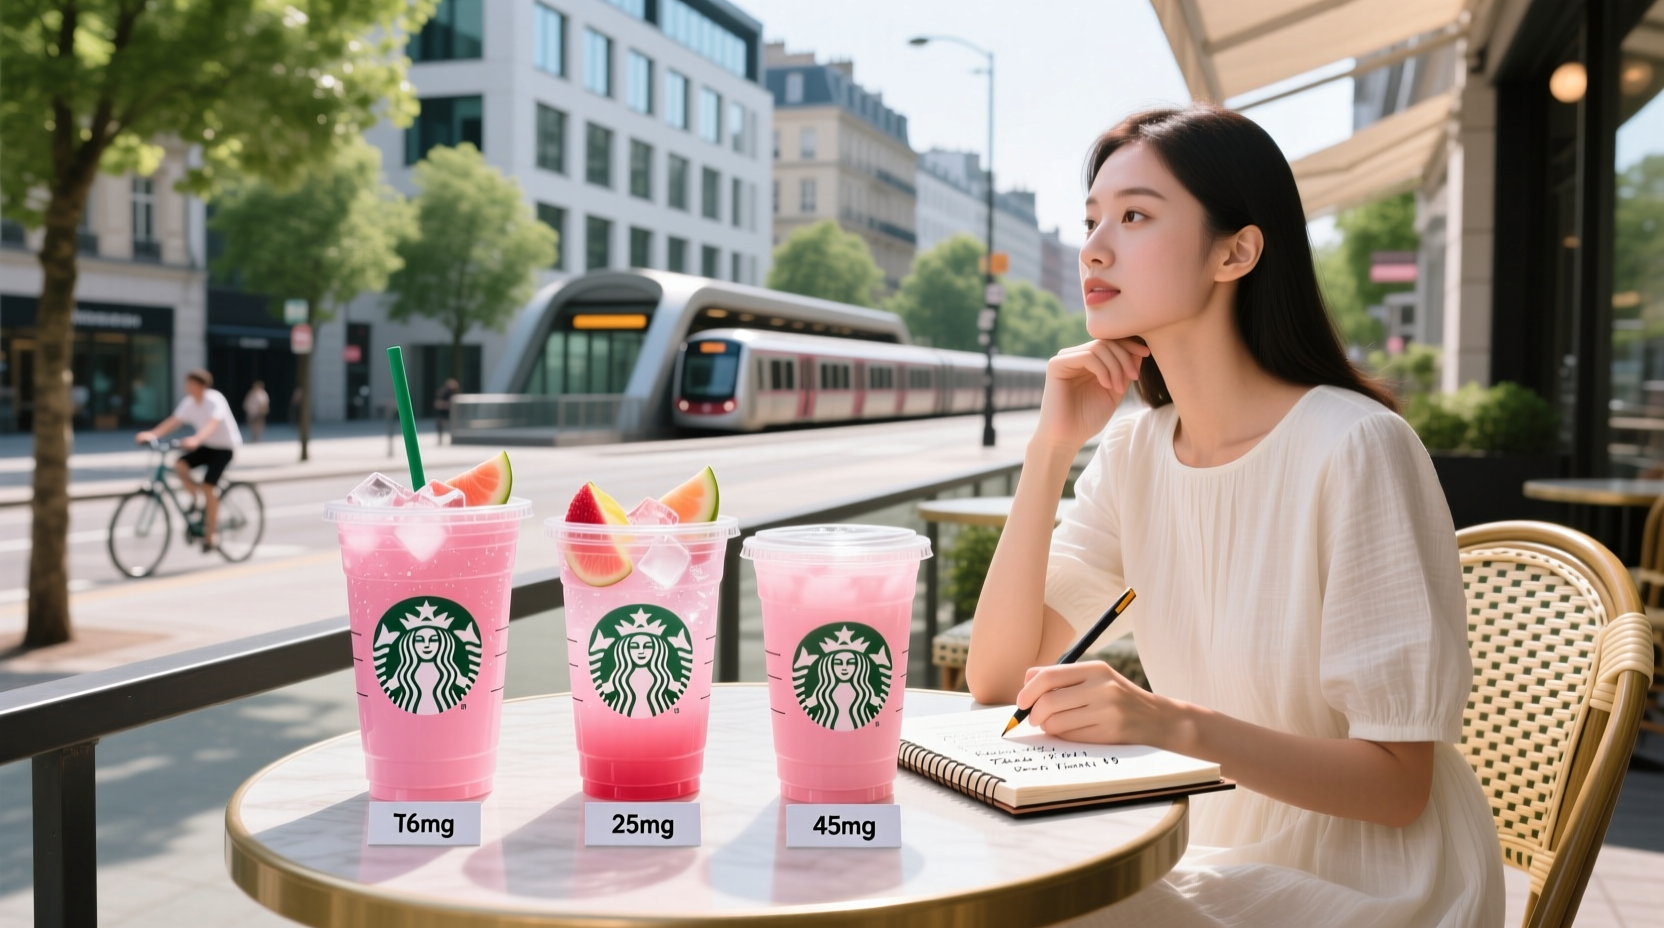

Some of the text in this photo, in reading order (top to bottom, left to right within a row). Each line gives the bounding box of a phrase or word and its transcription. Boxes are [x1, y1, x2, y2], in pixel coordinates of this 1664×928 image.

[393, 812, 455, 839] T6mg
[611, 813, 674, 840] 25mg
[812, 815, 876, 842] 45mg
